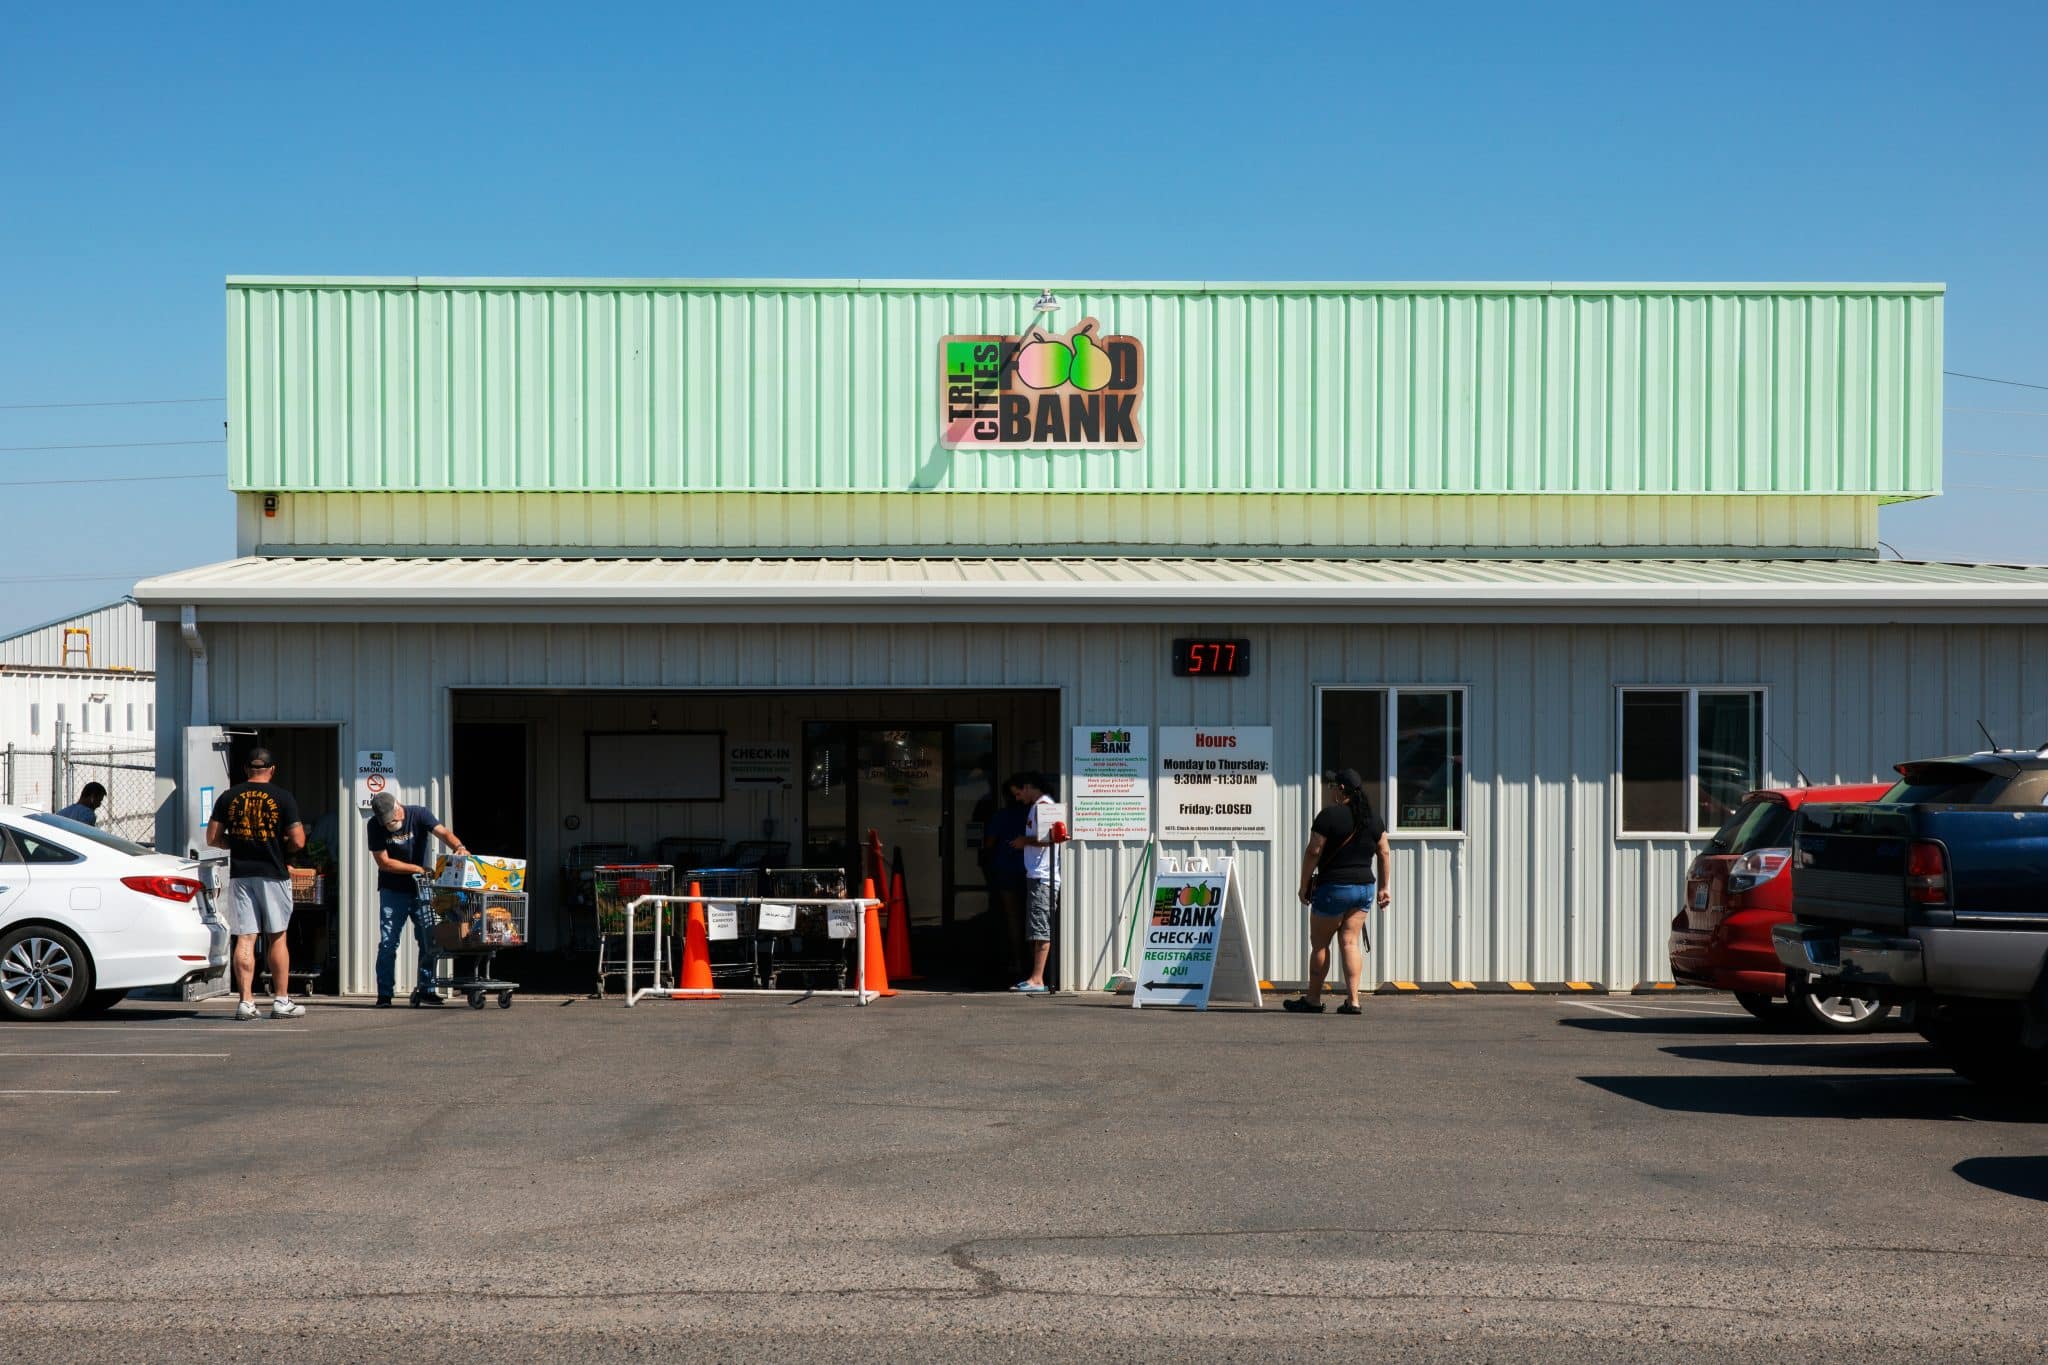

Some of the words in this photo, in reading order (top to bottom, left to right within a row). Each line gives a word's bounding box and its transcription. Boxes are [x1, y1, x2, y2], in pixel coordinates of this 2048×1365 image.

[948, 362, 973, 423] TRI-
[973, 344, 999, 441] CITIES
[1000, 394, 1138, 443] BANK
[1188, 644, 1236, 672] 577
[1196, 733, 1237, 748] Hours
[731, 748, 790, 760] CHECK-IN
[1102, 742, 1131, 754] BANK
[359, 766, 394, 774] SMOKING
[1164, 759, 1204, 771] Monday
[1206, 760, 1216, 770] to
[1218, 759, 1269, 772] Thursday:
[1174, 774, 1212, 785] 9:30AM
[240, 791, 269, 799] TREAD
[1179, 804, 1214, 816] Friday:
[1215, 804, 1252, 815] CLOSED
[1407, 807, 1441, 820] OPEN
[1169, 907, 1217, 927] BANK
[1149, 931, 1213, 944] CHECK-IN
[1144, 951, 1212, 961] REGISTRARSE
[1162, 966, 1188, 976] AQUI
